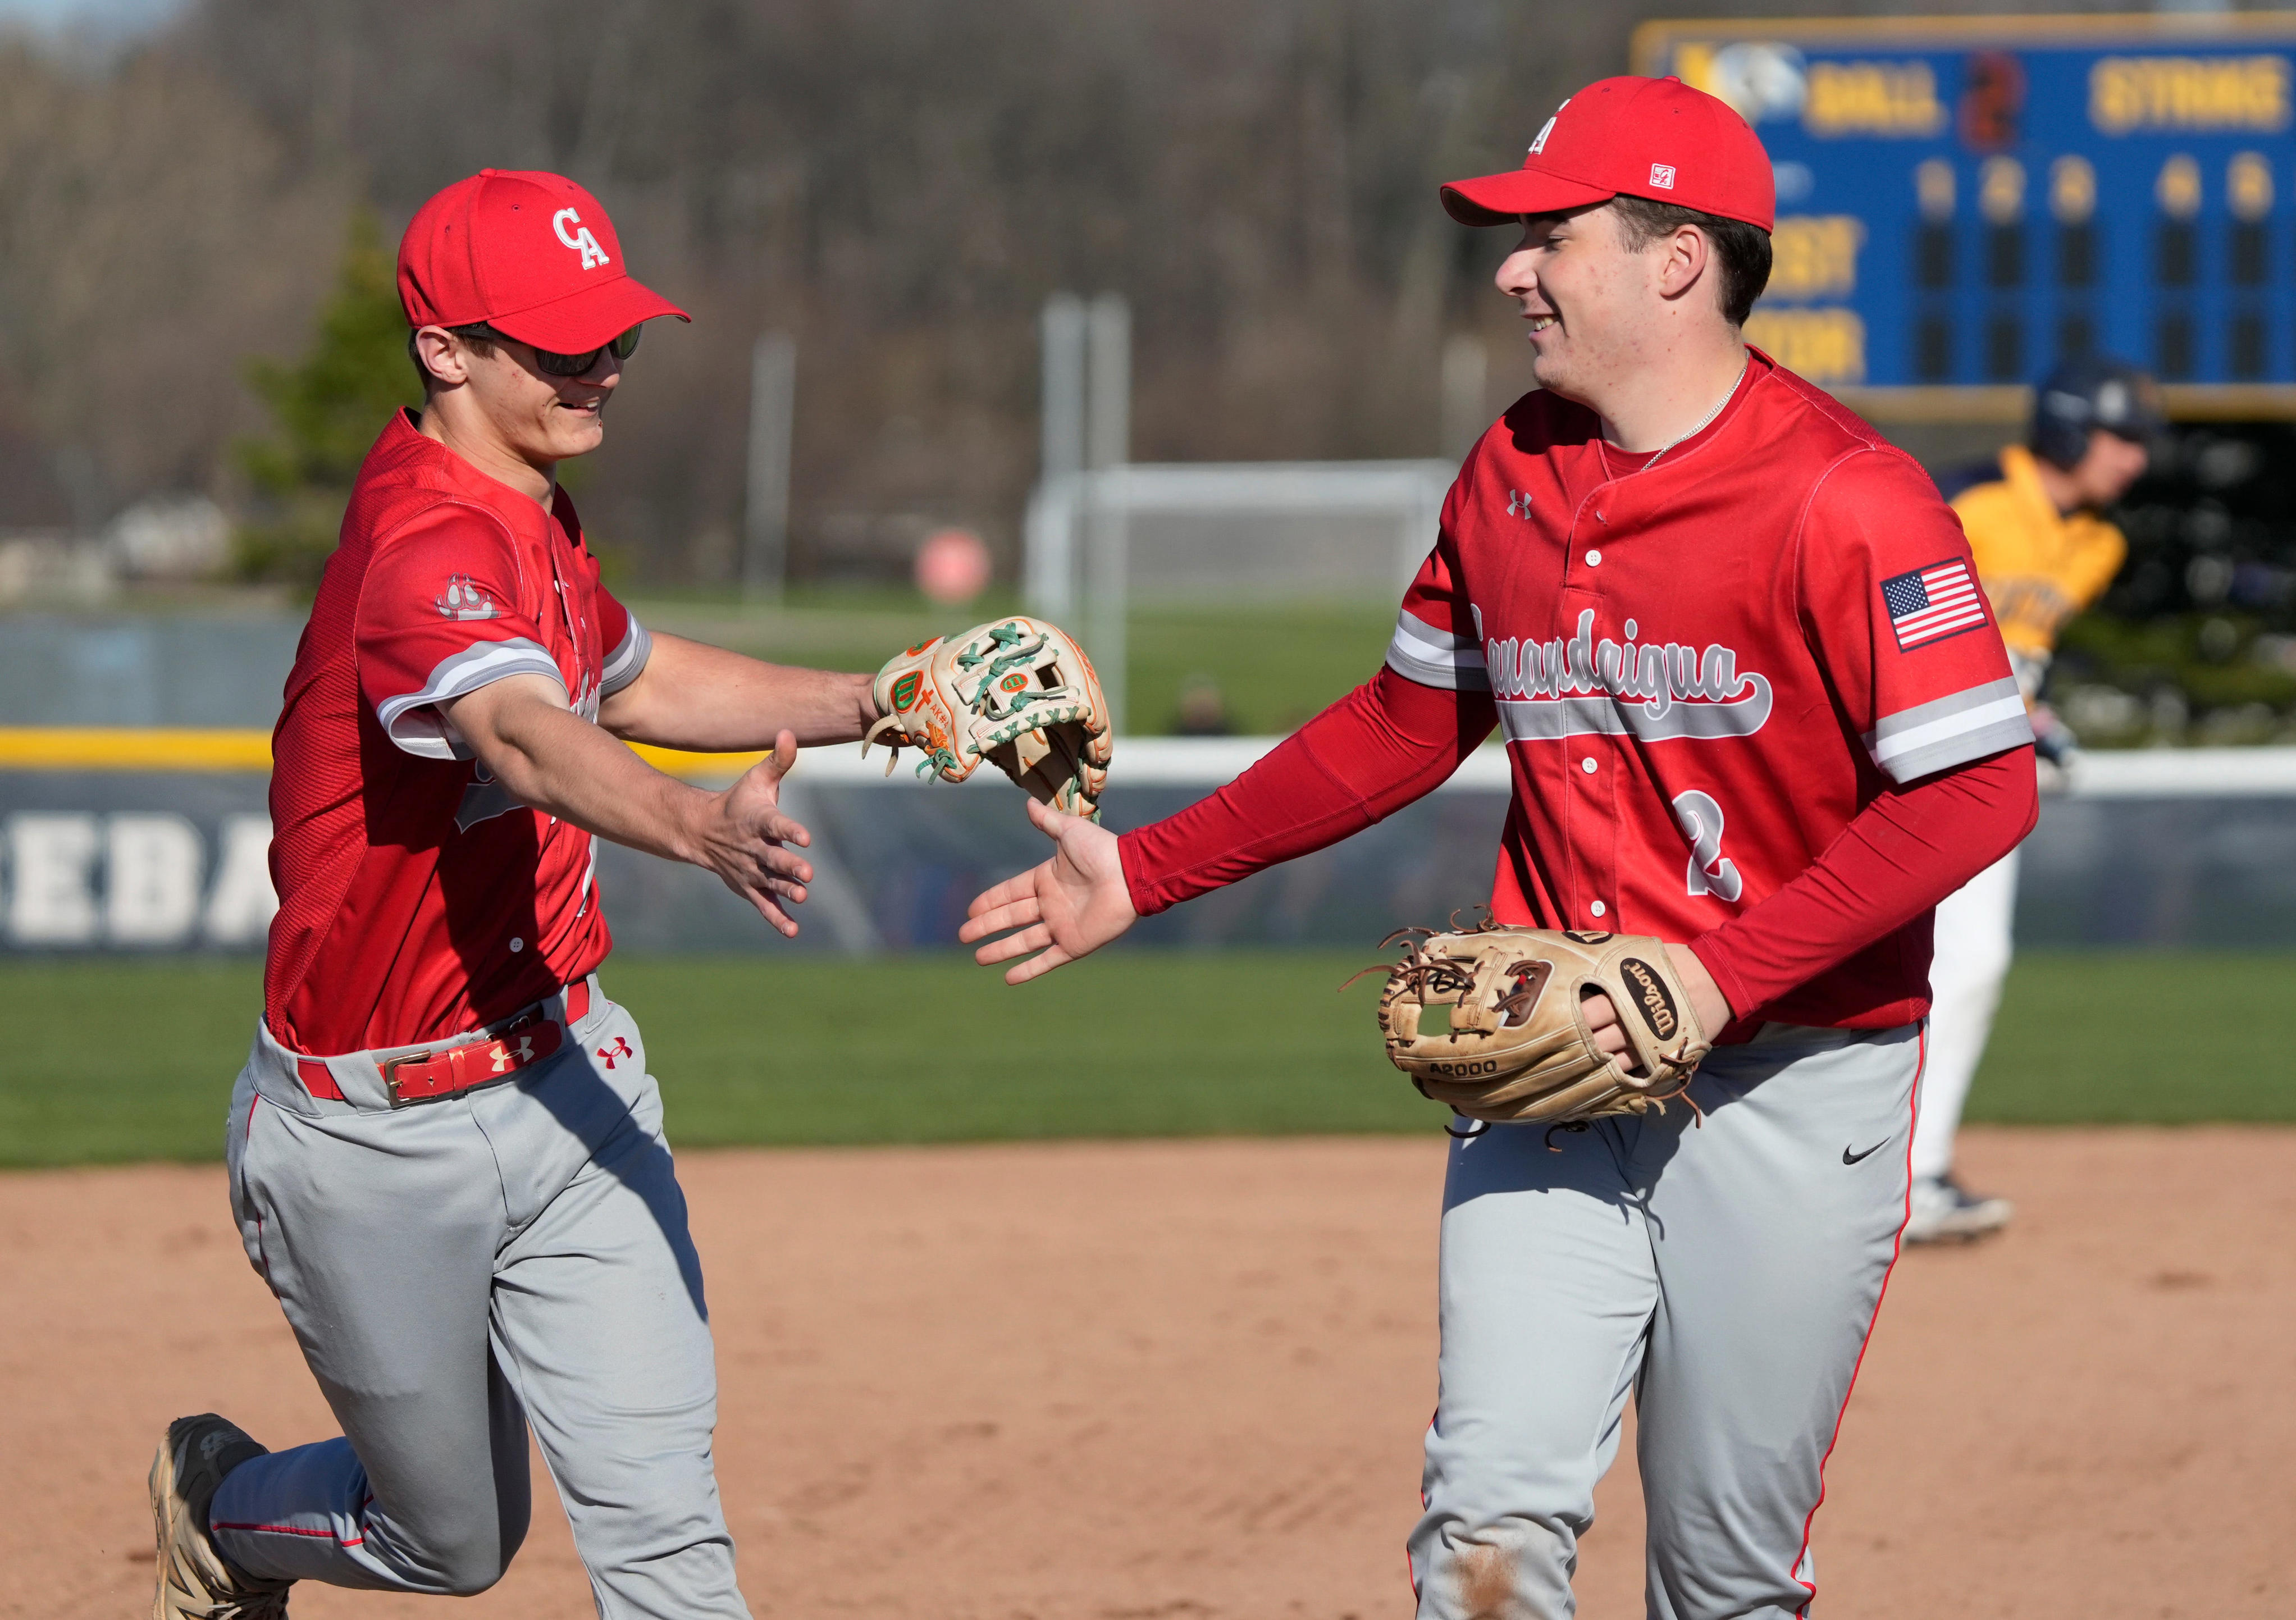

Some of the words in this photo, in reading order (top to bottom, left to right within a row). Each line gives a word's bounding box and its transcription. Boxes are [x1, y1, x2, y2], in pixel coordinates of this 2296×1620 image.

[553, 207, 610, 270] CA
[1471, 603, 1773, 744] anandaigua
[1672, 789, 1742, 902] 2
[1629, 962, 1675, 1036] Wilson
[1430, 1060, 1498, 1076] A2000
